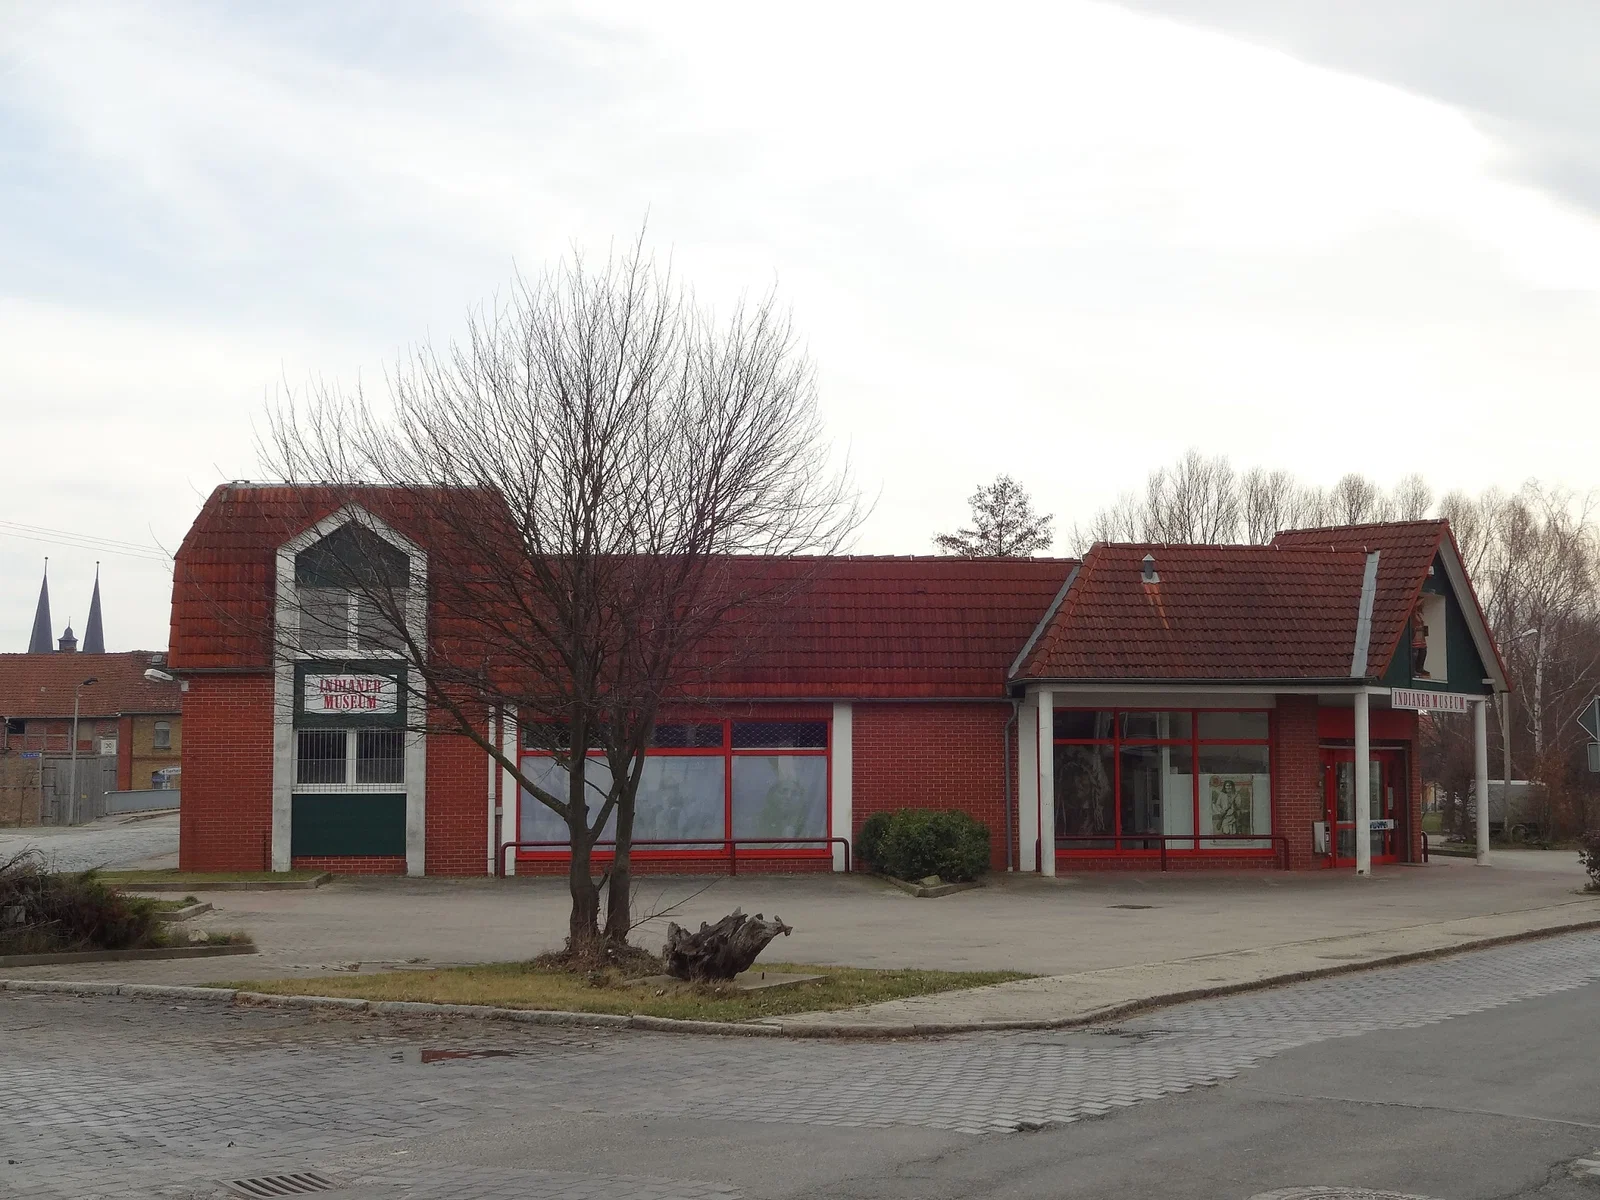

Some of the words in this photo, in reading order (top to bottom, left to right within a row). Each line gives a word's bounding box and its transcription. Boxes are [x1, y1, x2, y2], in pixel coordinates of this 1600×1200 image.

[323, 694, 377, 709] MUSEUM
[1394, 691, 1430, 708] INDIANER
[1432, 694, 1465, 710] MUSEUM
